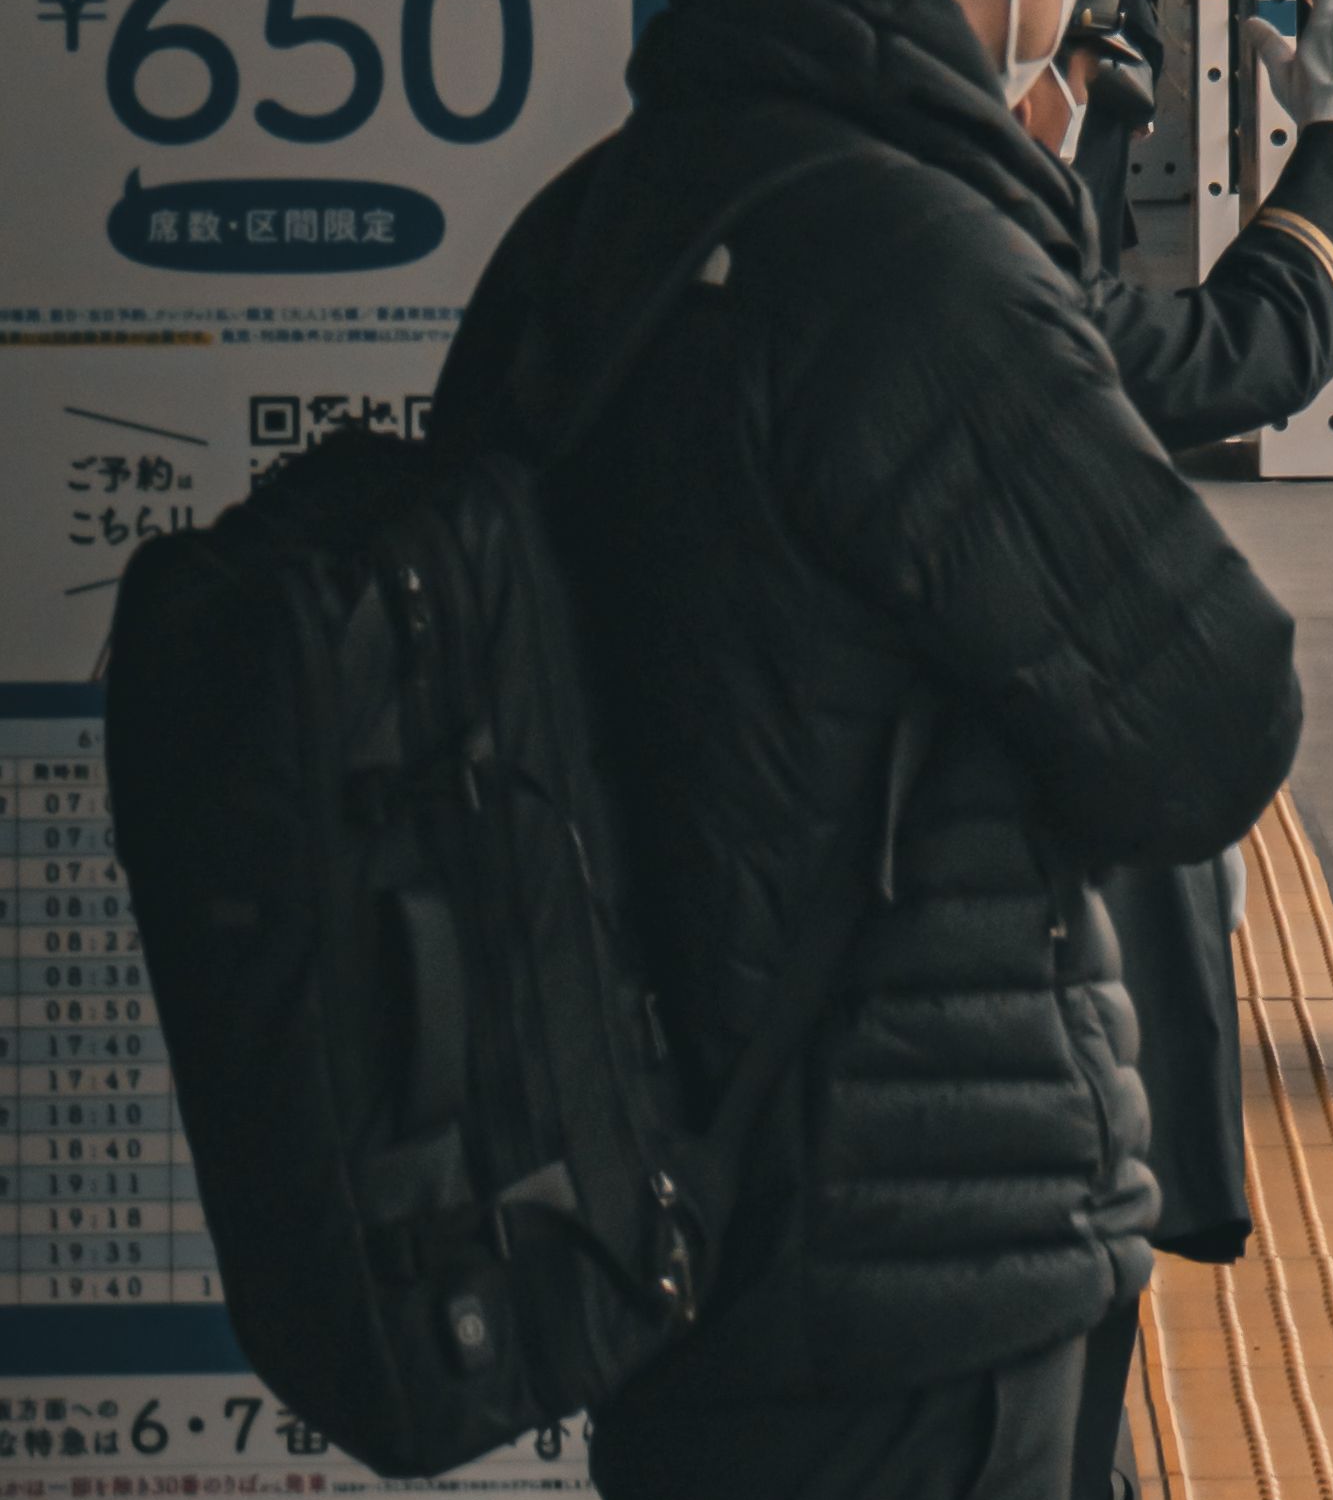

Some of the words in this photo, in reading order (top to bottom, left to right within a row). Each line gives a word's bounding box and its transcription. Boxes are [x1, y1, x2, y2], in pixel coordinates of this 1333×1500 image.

[146, 206, 398, 245] 席数・区間限定
[66, 455, 193, 494] ご予約は
[45, 896, 133, 918] 08:0
[48, 1035, 142, 1057] 17:40
[48, 1070, 142, 1091] 17:47
